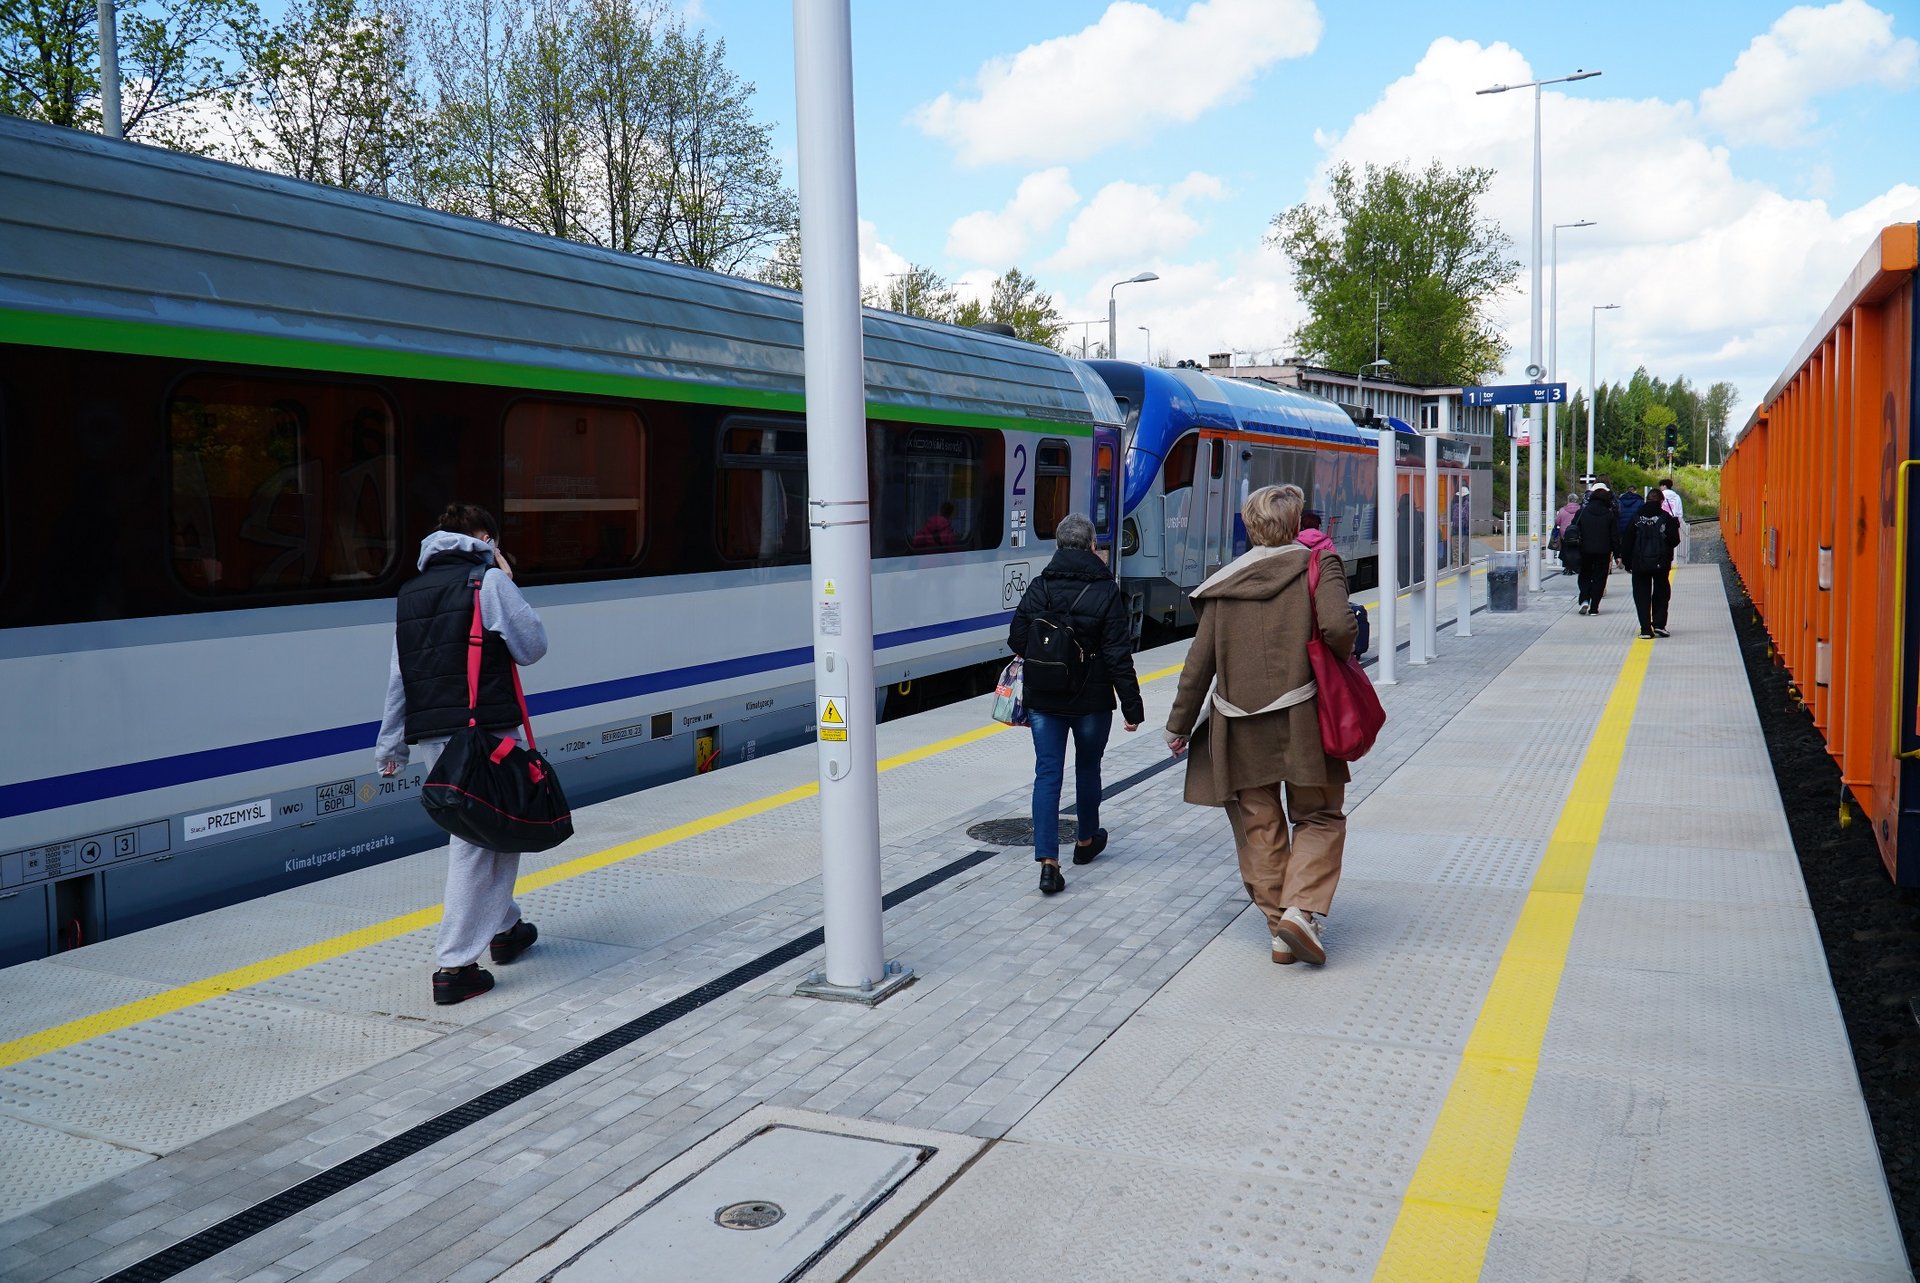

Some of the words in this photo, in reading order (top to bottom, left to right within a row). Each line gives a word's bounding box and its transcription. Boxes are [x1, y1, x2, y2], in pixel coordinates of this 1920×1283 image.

[1468, 392, 1475, 404] 1
[1552, 388, 1561, 400] 3
[1012, 443, 1027, 496] 2
[745, 698, 774, 711] Klimatyzacja
[319, 787, 334, 799] 44t
[338, 783, 353, 795] 49t
[379, 783, 395, 796] 70t
[398, 776, 421, 791] FL-R
[208, 804, 266, 830] PRZEMYŚL
[121, 838, 129, 851] 3
[285, 834, 395, 873] Klimatyzacja-sprężarka
